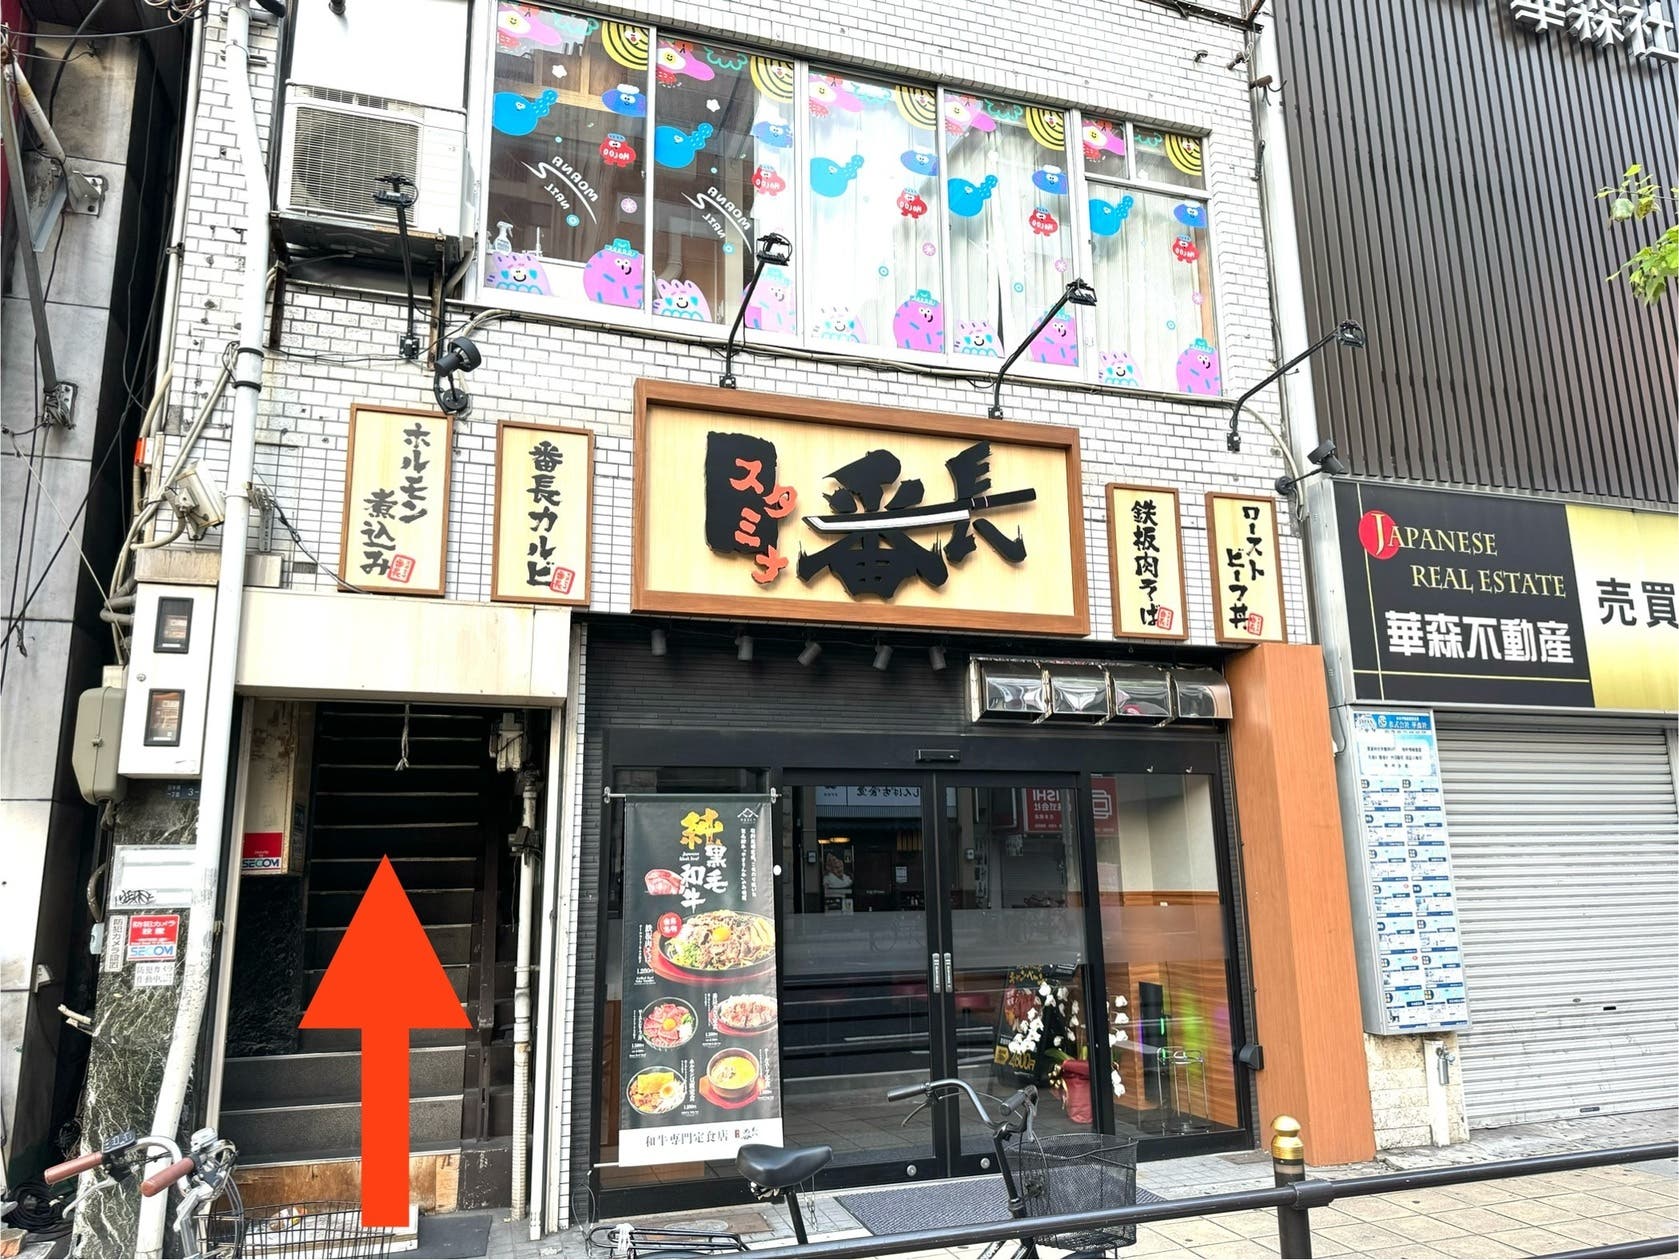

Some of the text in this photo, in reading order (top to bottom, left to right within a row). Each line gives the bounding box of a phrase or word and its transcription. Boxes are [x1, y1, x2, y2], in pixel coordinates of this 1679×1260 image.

[398, 422, 431, 523] ホルモン
[360, 488, 398, 576] 煮込み
[526, 440, 564, 587] 番長カルビ
[1242, 506, 1265, 581] ロースト
[1370, 513, 1498, 556] JAPANESE
[1131, 499, 1161, 626] 鉄板肉そば
[1226, 547, 1250, 630] ビーフ丼
[1411, 564, 1566, 598] REAL ESTATE
[1596, 577, 1679, 630] 売買
[679, 863, 706, 914] 和牛
[130, 945, 174, 956] SECOM
